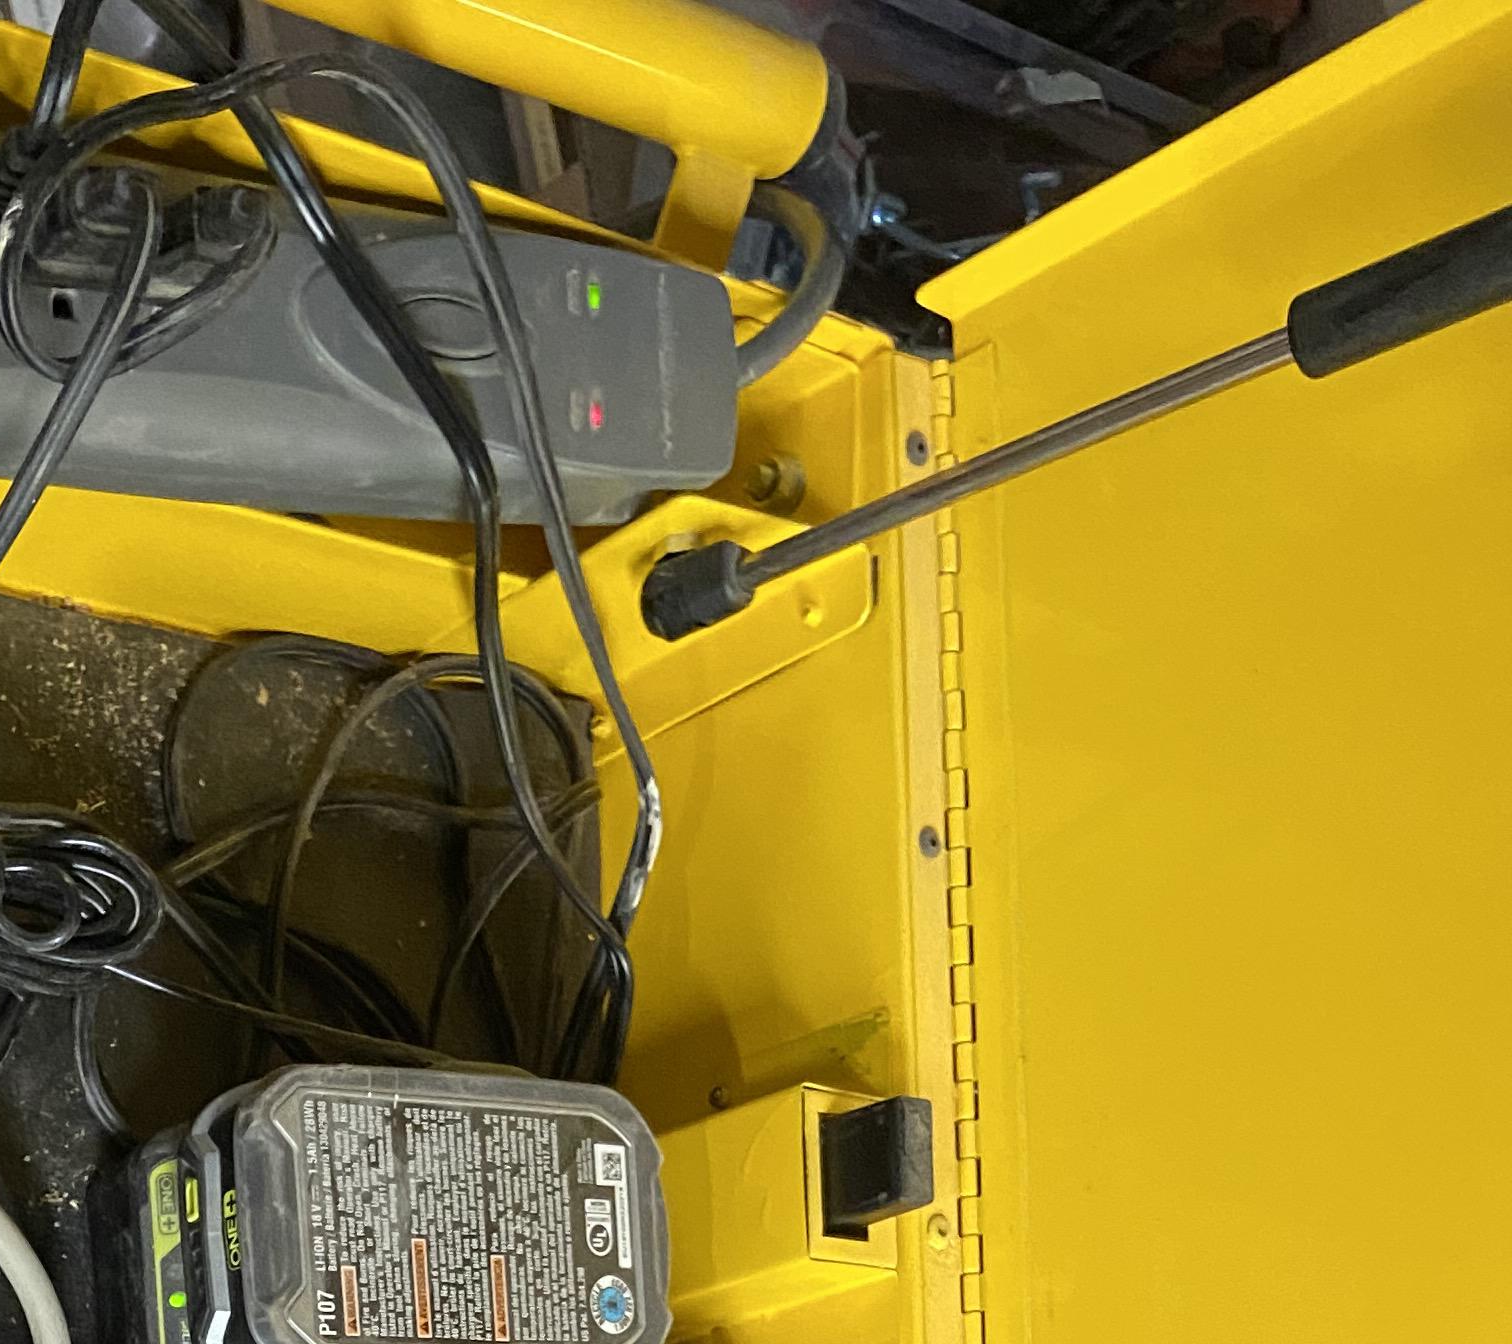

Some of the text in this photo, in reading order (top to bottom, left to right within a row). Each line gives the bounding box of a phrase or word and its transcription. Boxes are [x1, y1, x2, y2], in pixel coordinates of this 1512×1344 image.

[303, 1099, 315, 1131] 28Wh
[311, 1203, 321, 1213] V
[312, 1235, 326, 1271] LI-ION
[316, 1290, 337, 1336] P107
